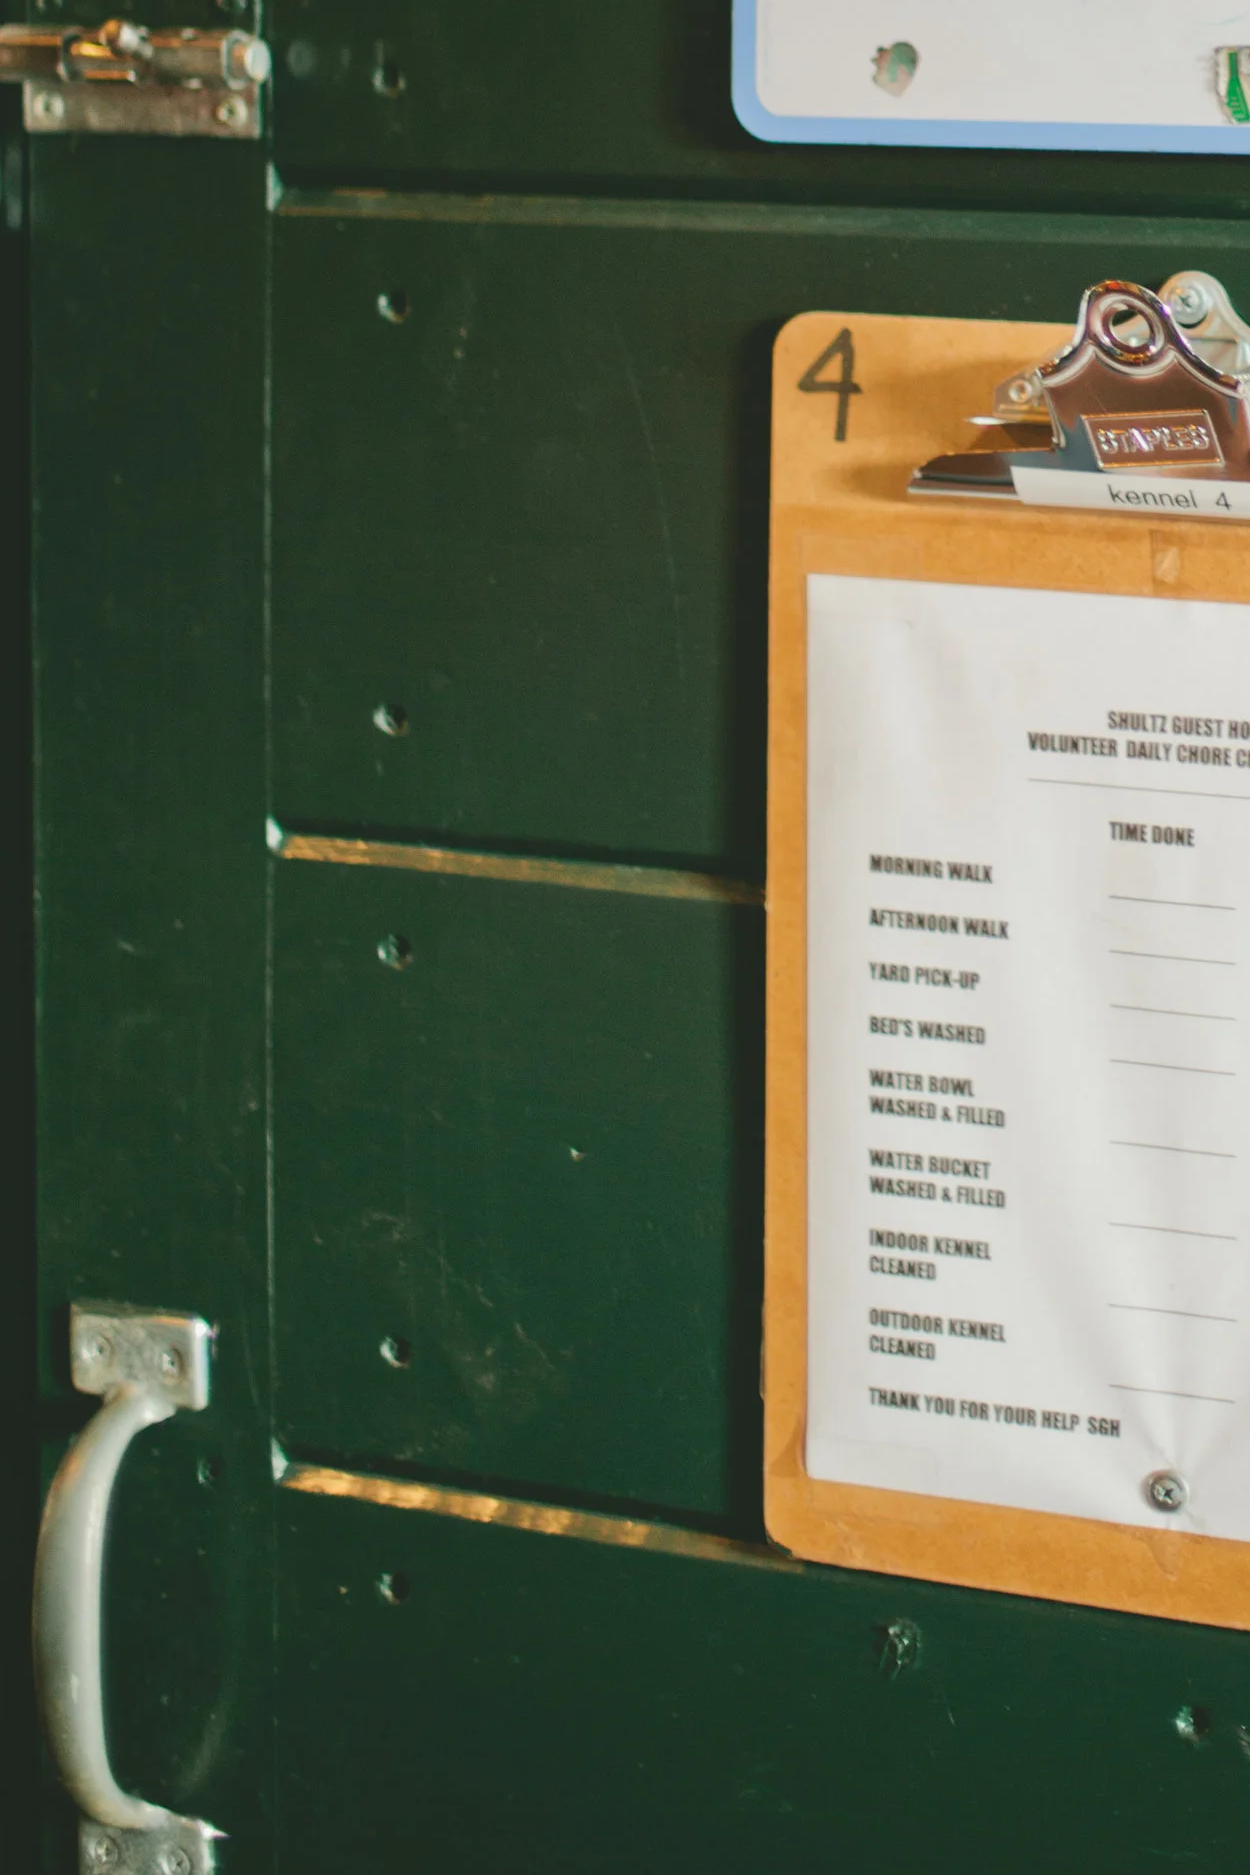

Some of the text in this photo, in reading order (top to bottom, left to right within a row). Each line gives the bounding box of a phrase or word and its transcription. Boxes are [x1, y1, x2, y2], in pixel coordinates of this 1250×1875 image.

[797, 327, 863, 442] 4
[1098, 424, 1210, 454] STAPLES
[1107, 483, 1232, 511] kennel 4
[1108, 711, 1167, 733] SHULTZ
[1172, 716, 1224, 738] GUEST
[1028, 732, 1118, 757] VOLUNTEER
[1126, 740, 1172, 761] DAILY
[1176, 744, 1231, 766] CHORE
[1109, 821, 1195, 847] TIME DONE
[870, 854, 993, 884] MORNING WALK
[869, 908, 1009, 939] AFTERNOON WALK
[869, 962, 980, 990] YARD PICK-UP
[869, 1016, 986, 1045] BED'S WASHED
[869, 1069, 974, 1097] WATER BOWL
[869, 1096, 1005, 1128] WASHED & FILLED
[869, 1149, 990, 1179] WATER BUCKET
[869, 1176, 1006, 1209] WASHED & FILLED
[869, 1229, 991, 1260] INDOOR KENNEL
[869, 1255, 936, 1280] CLEANED
[869, 1308, 1006, 1343] OUTDOOR KENNEL
[869, 1335, 936, 1361] CLEANED
[869, 1387, 920, 1411] THANK
[924, 1395, 955, 1416] YOU
[960, 1400, 989, 1421] FOR
[993, 1405, 1037, 1427] YOUR
[1041, 1410, 1080, 1431] HELP
